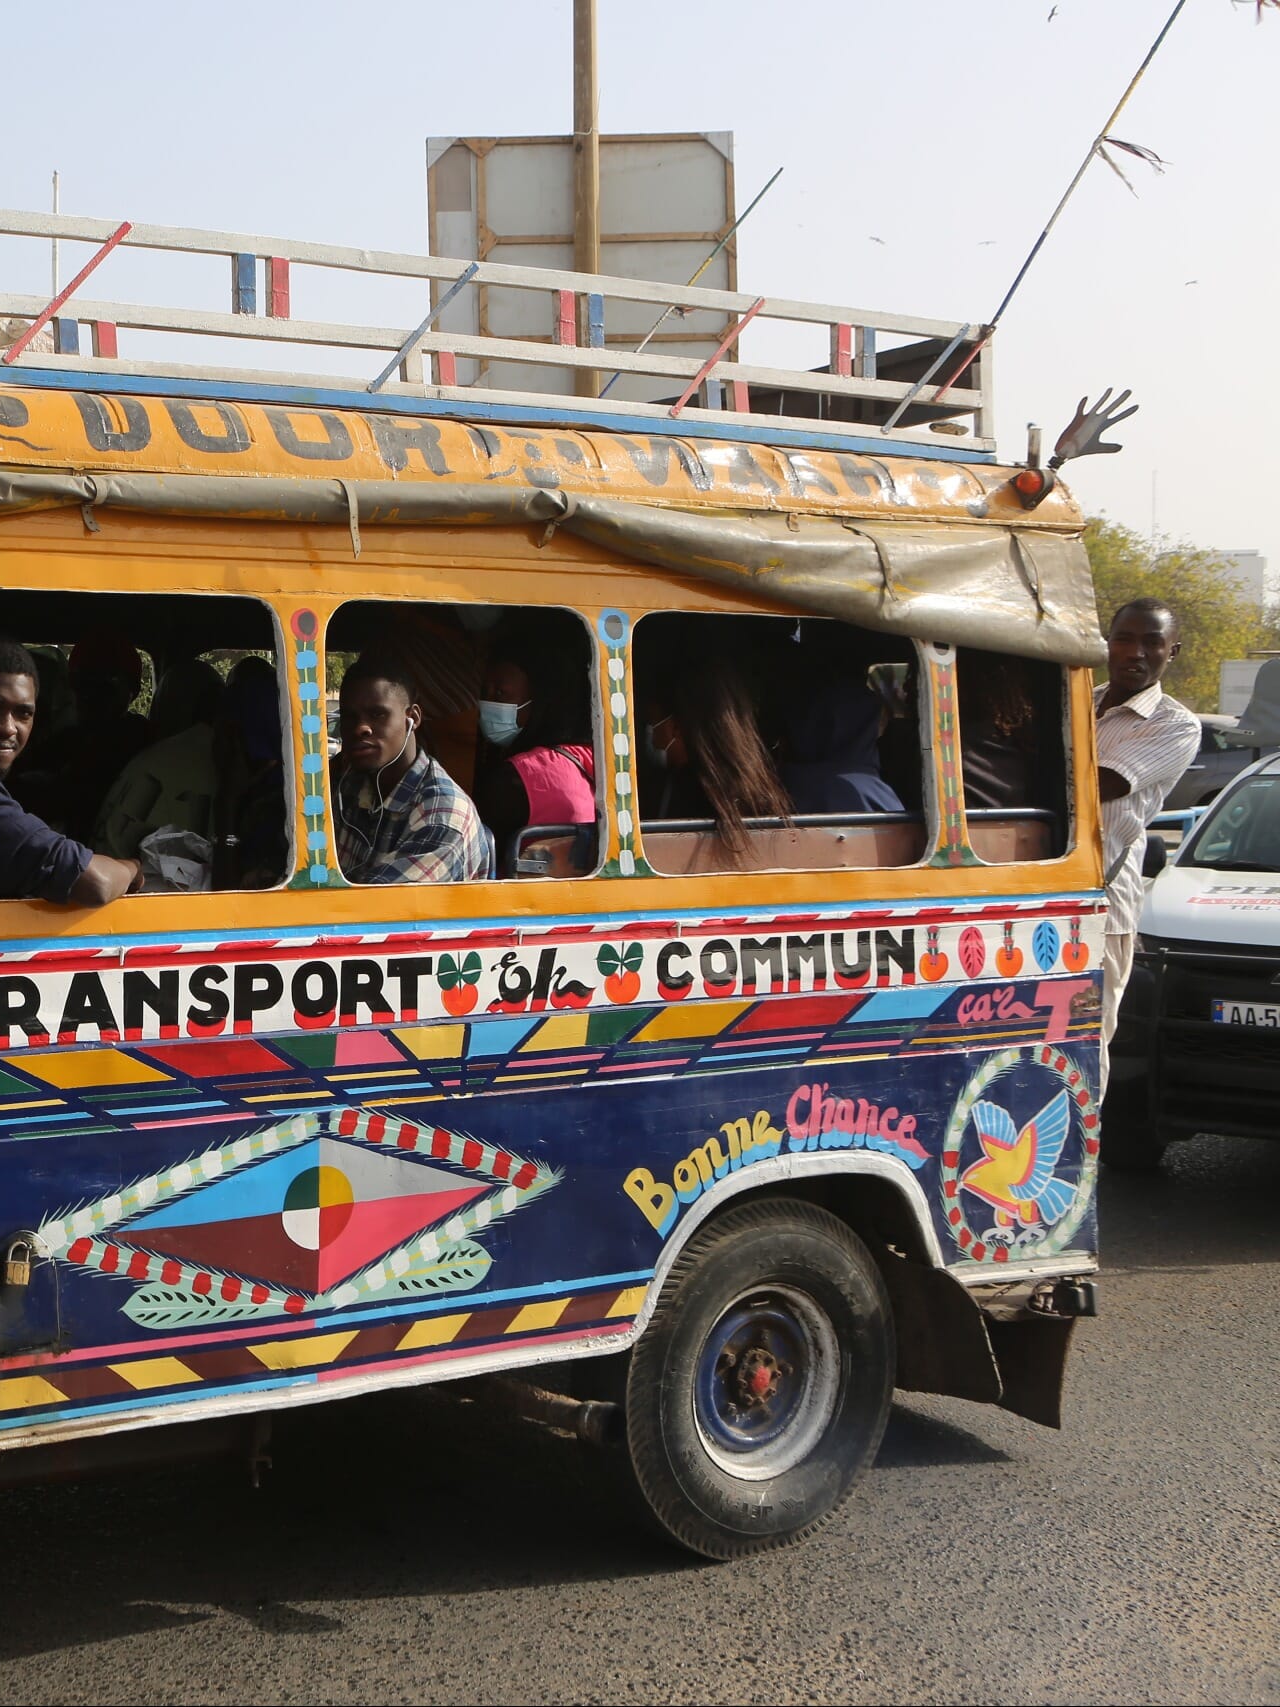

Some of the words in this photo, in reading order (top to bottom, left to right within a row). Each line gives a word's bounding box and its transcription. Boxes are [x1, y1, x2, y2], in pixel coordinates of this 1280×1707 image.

[656, 929, 916, 1002] COMMUN
[622, 1110, 787, 1239] Bonne
[785, 1082, 934, 1170] Chance
